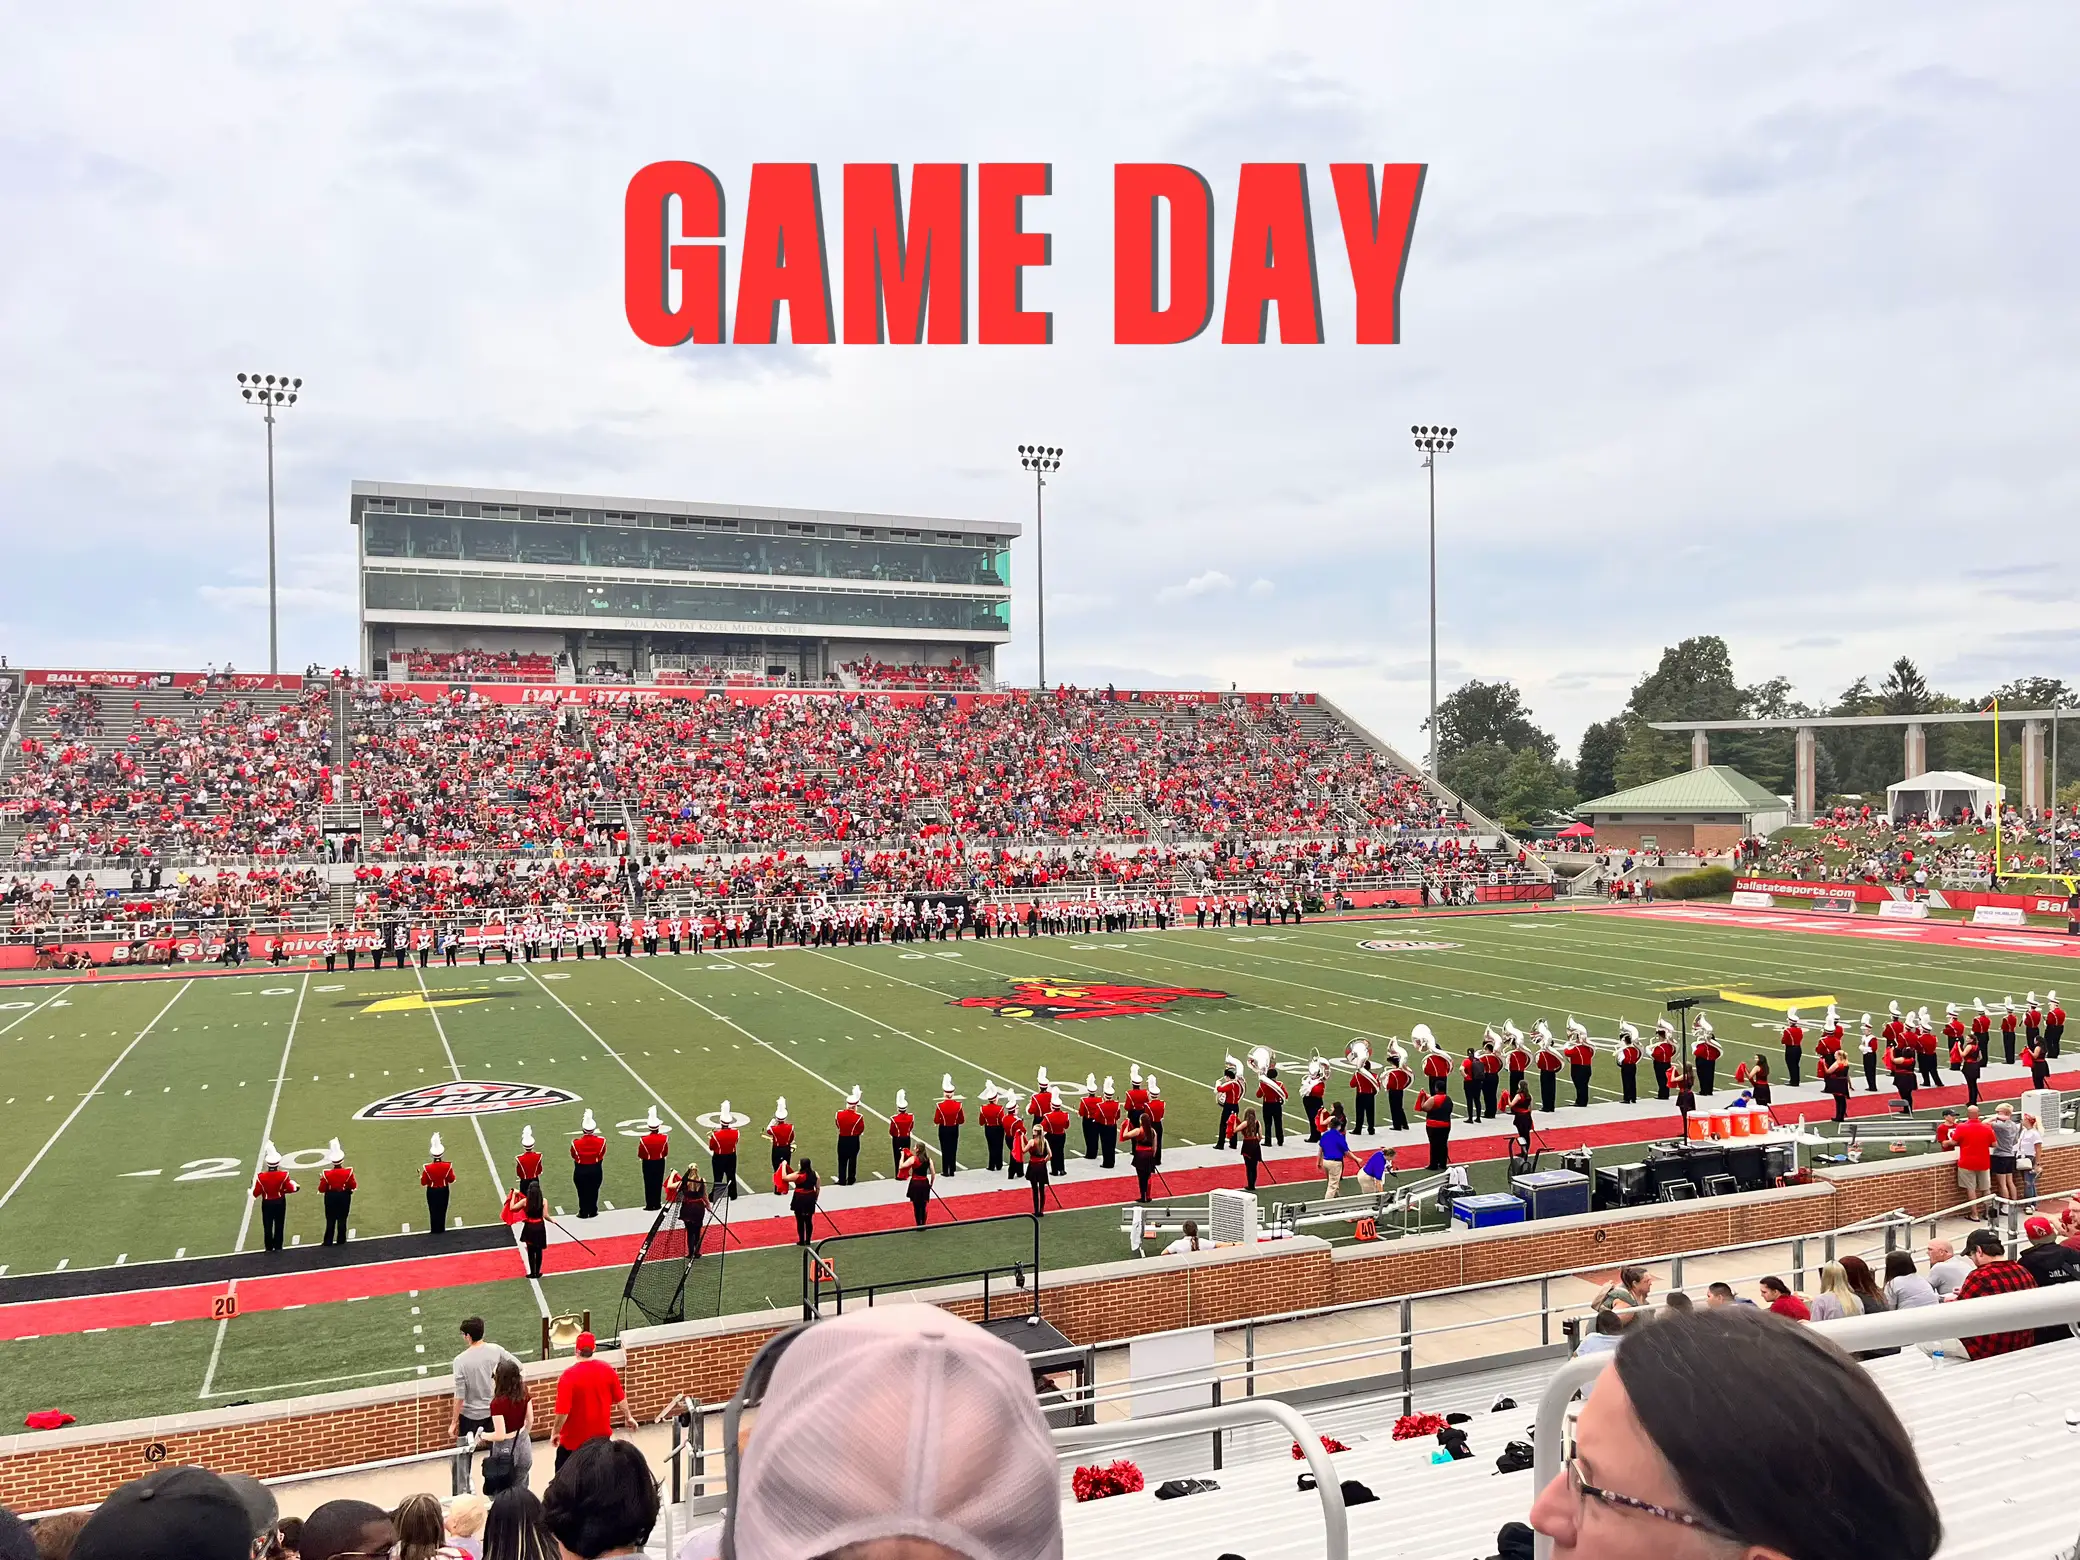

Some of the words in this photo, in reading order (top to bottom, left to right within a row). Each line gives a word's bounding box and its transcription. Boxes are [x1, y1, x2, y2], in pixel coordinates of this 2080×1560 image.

[624, 619, 649, 629] PAUL
[652, 620, 676, 630] AND
[699, 622, 728, 632] KOZEL
[732, 623, 762, 633] MEDIA
[766, 624, 805, 634] CENTER
[47, 673, 86, 683] BALL
[90, 673, 138, 684] SATE
[521, 689, 583, 703] BALL
[1736, 880, 1857, 898] ballstatesports.com
[2036, 899, 2069, 912] Bal
[172, 1148, 334, 1182] 20
[1361, 1221, 1375, 1237] 40
[215, 1297, 236, 1316] 20
